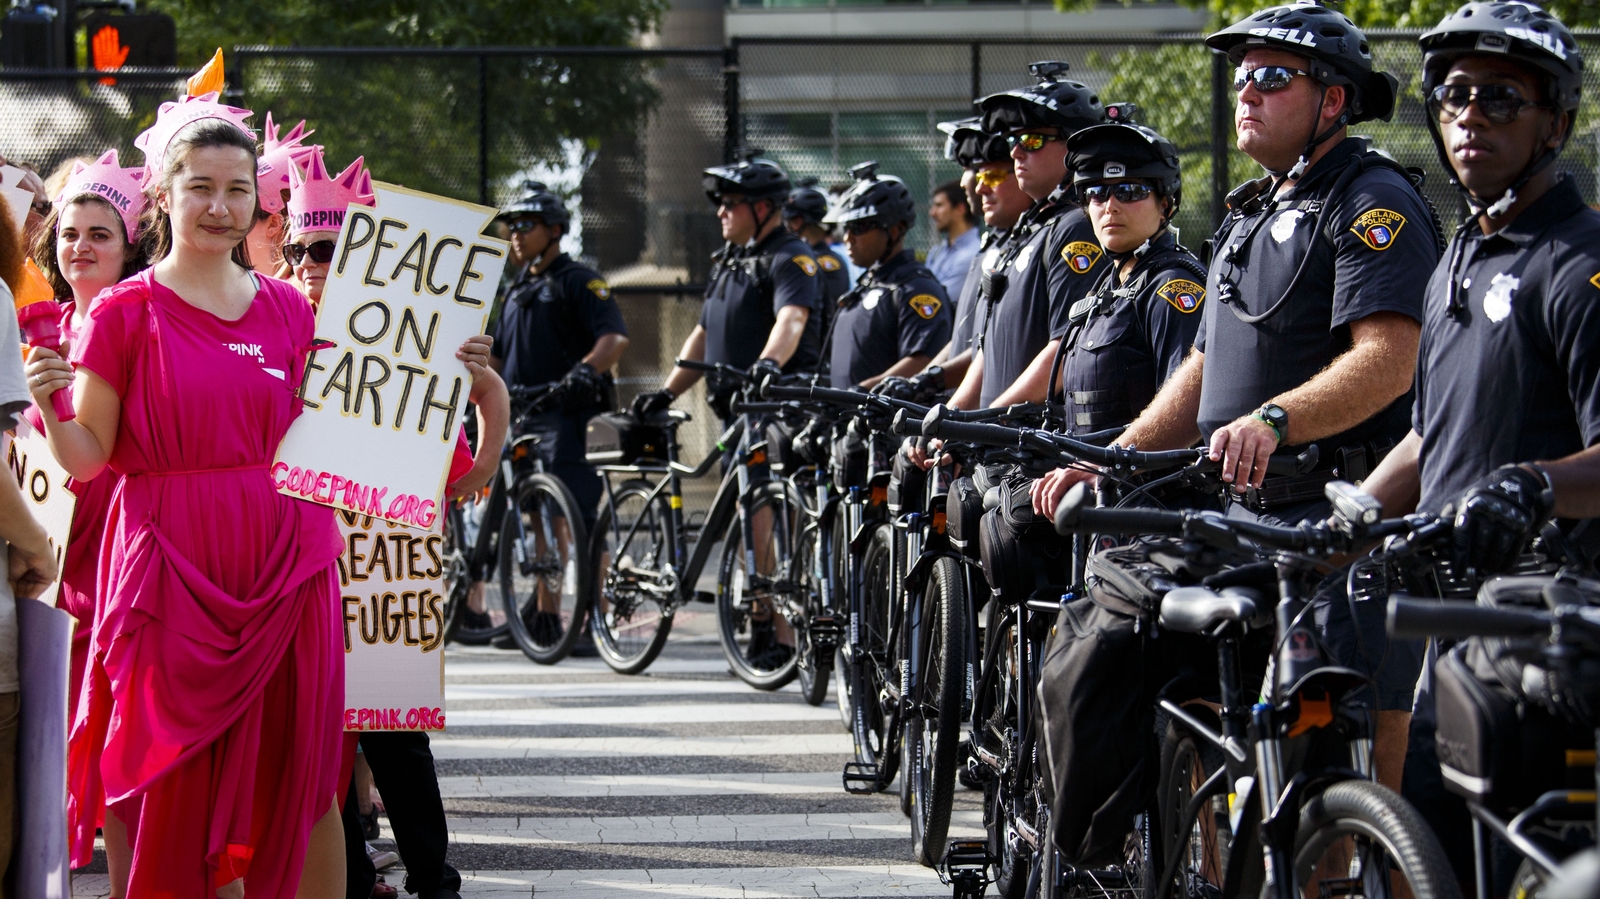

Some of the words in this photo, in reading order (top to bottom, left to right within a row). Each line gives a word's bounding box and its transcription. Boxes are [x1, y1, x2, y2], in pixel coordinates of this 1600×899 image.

[1248, 28, 1317, 48] BELL
[1503, 27, 1567, 61] BELL
[78, 182, 132, 212] DEPINK
[292, 210, 347, 230] CODEPIN
[1361, 217, 1392, 228] POLICE
[336, 211, 503, 308] PEACE
[348, 301, 441, 361] ON
[222, 343, 264, 357] PINK
[299, 338, 463, 442] EARTH
[9, 440, 49, 503] NO
[270, 461, 437, 528] CODEPINK.ORG
[343, 706, 446, 731] EPINK.ORG
